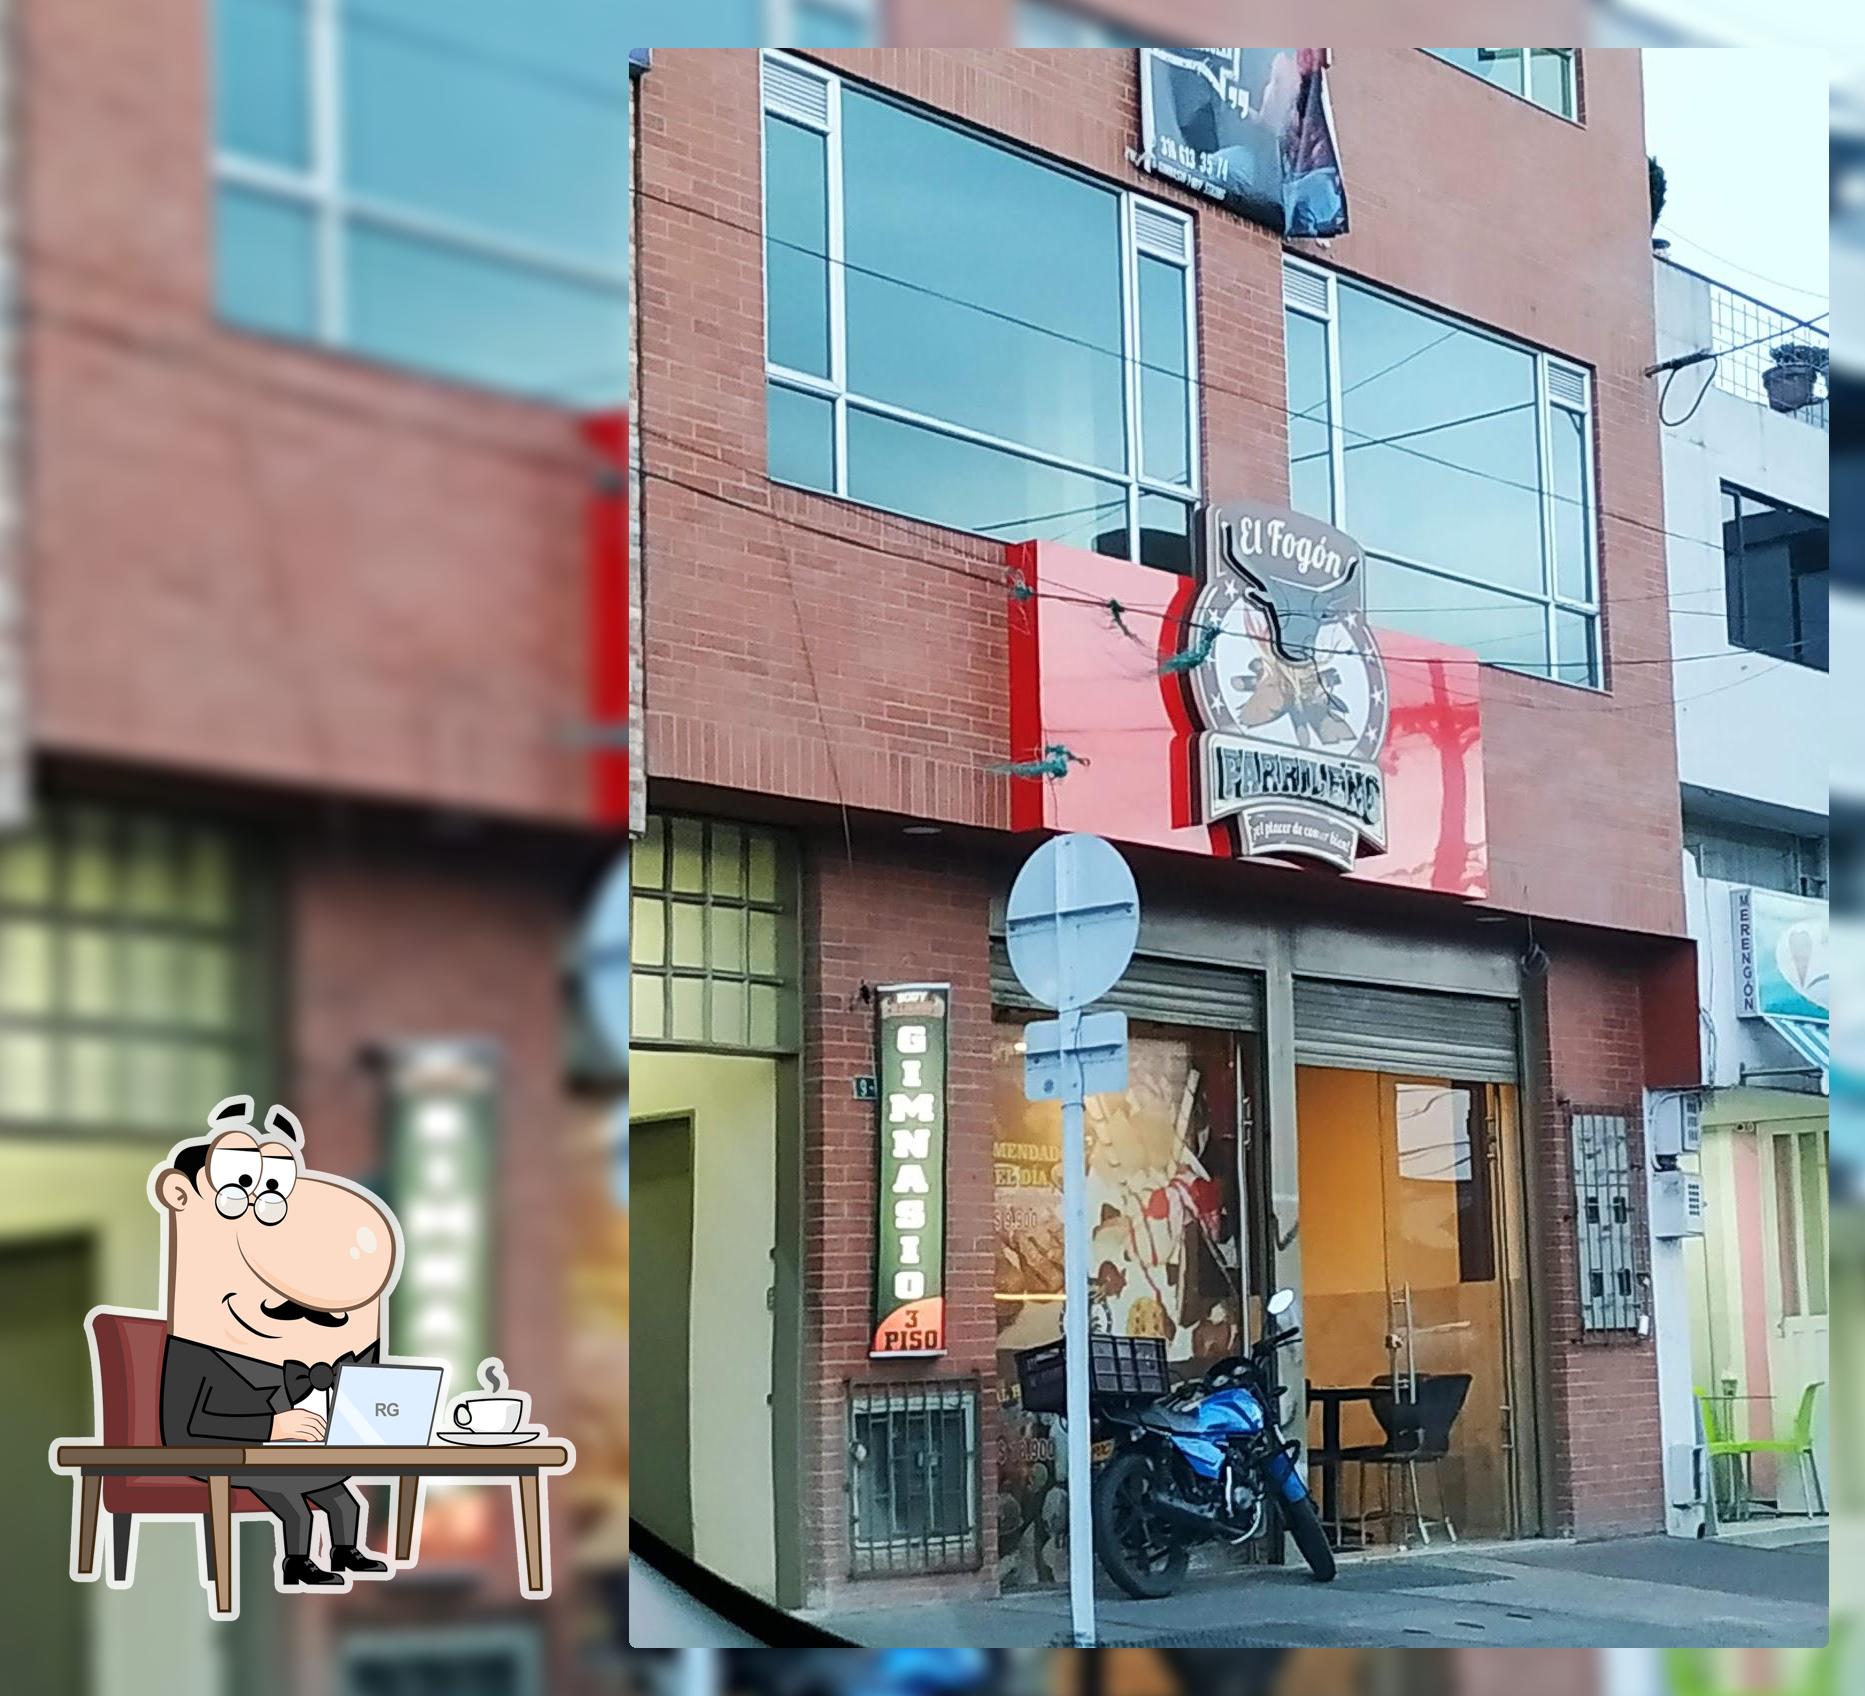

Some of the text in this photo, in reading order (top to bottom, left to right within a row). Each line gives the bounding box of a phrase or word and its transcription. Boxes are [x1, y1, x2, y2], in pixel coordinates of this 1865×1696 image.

[1199, 151, 1214, 177] 35
[1240, 516, 1342, 578] El Fogón
[1292, 822, 1302, 837] de
[889, 1025, 935, 1300] GIMNASIO
[992, 1142, 1063, 1162] MENDAD
[905, 1310, 919, 1328] 3
[884, 1330, 938, 1351] PISO
